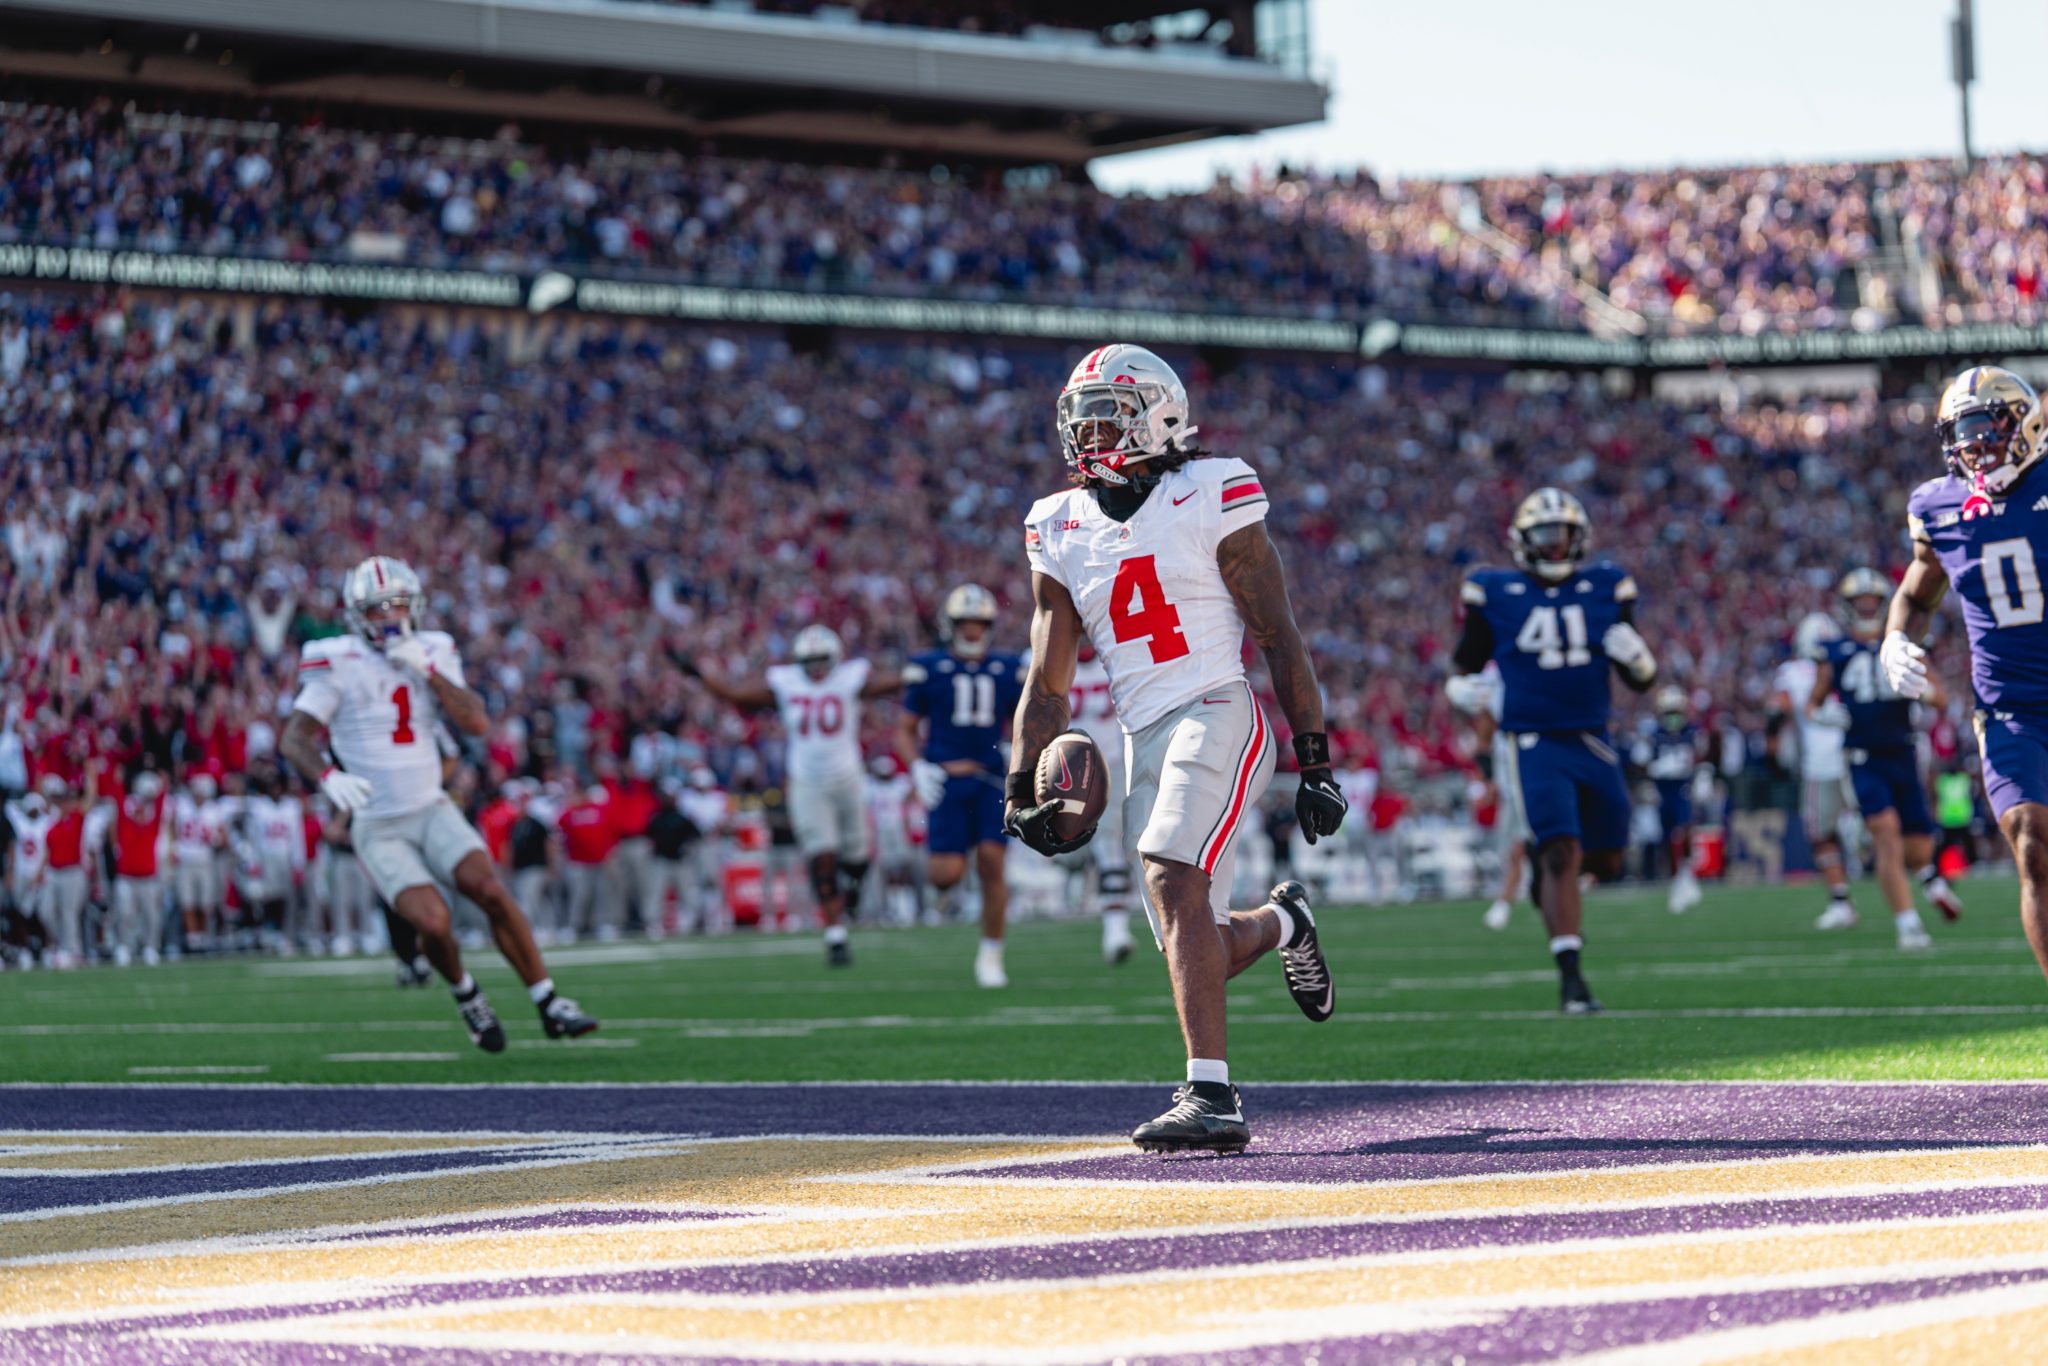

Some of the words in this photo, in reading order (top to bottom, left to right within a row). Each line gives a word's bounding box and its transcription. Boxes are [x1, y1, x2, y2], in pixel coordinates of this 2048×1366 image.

[1109, 554, 1190, 664] 4
[1981, 537, 2044, 629] 0
[1515, 604, 1591, 670] 41
[391, 684, 416, 745] 1
[788, 694, 845, 737] 70
[952, 673, 995, 727] 11
